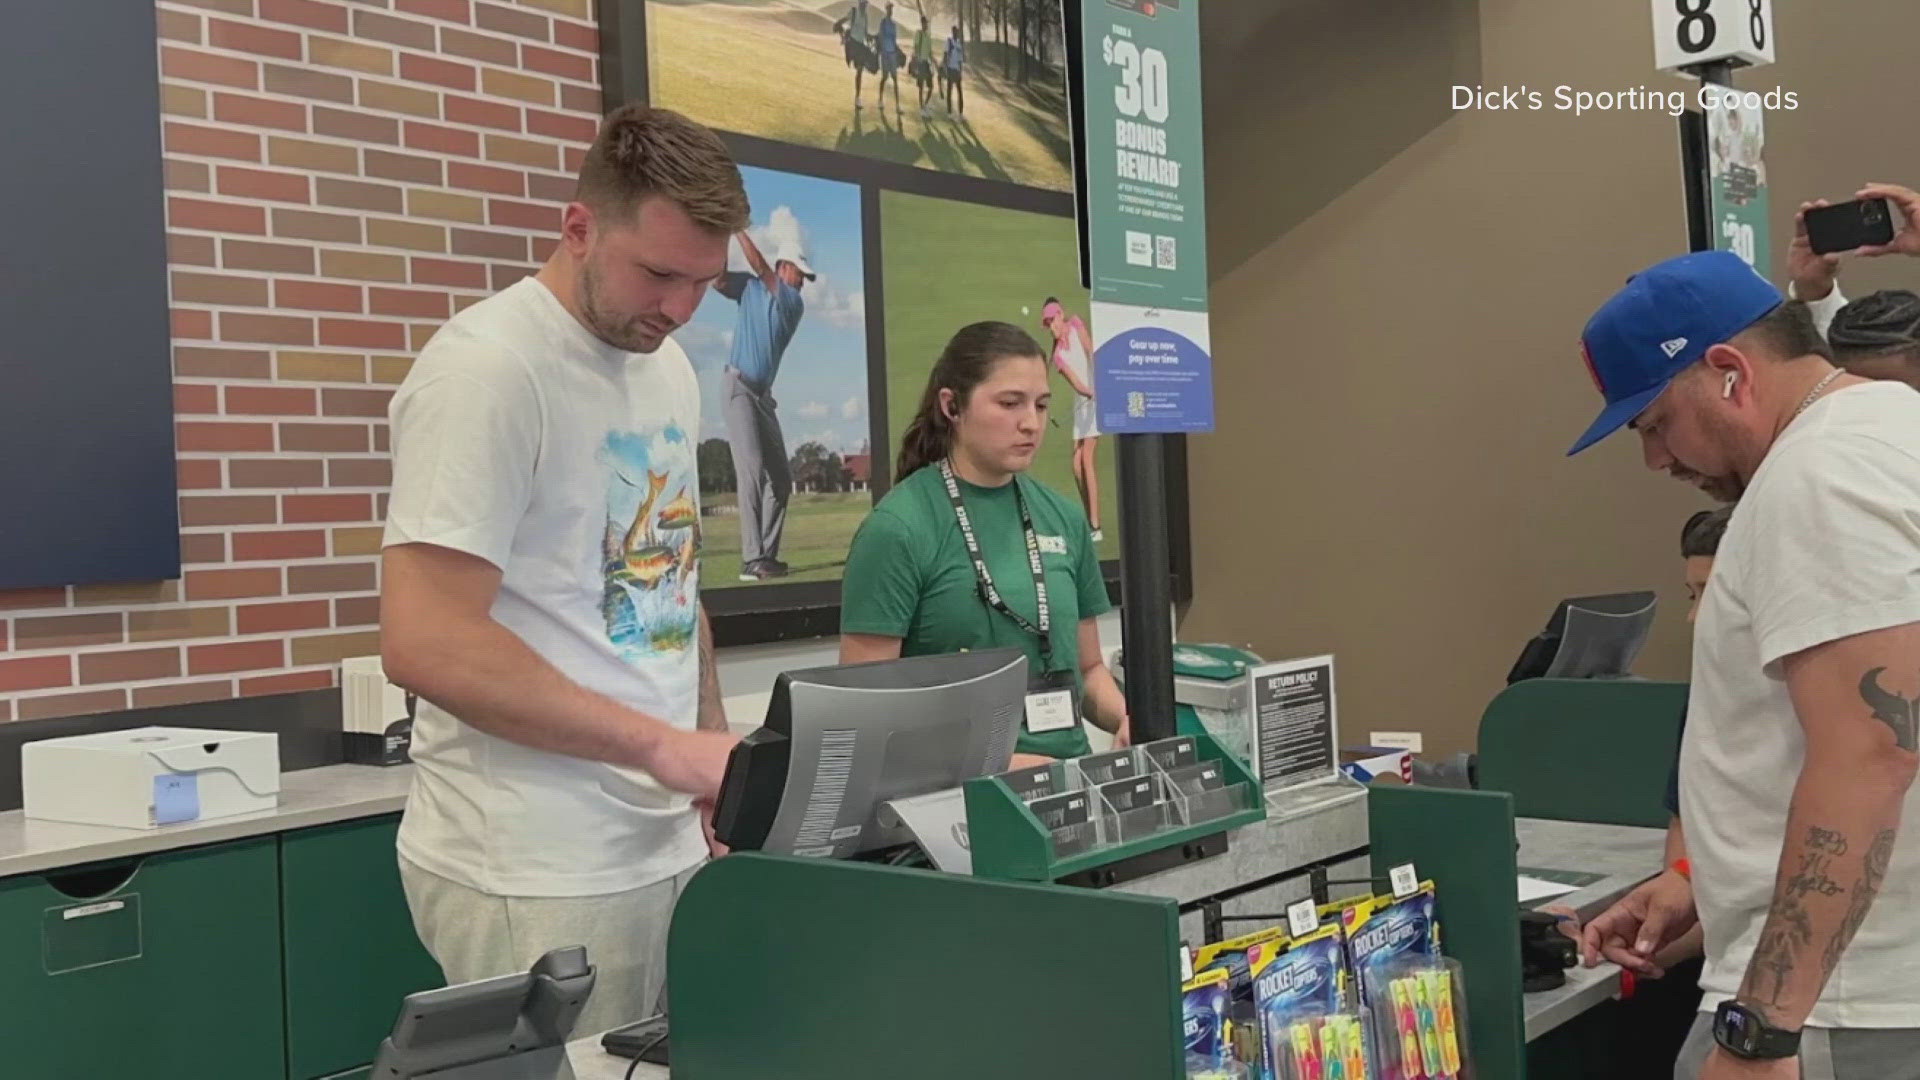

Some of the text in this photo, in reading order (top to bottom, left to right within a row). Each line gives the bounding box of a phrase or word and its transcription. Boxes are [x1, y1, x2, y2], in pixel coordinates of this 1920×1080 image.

[1675, 0, 1716, 54] 8
[1749, 0, 1765, 51] 8
[1102, 34, 1169, 123] $30
[1116, 119, 1167, 156] BONUS
[1128, 339, 1177, 353] Gear up now,
[1128, 353, 1179, 365] pay over time
[1355, 923, 1388, 958] ROCKET
[1259, 965, 1294, 1001] ROCKET
